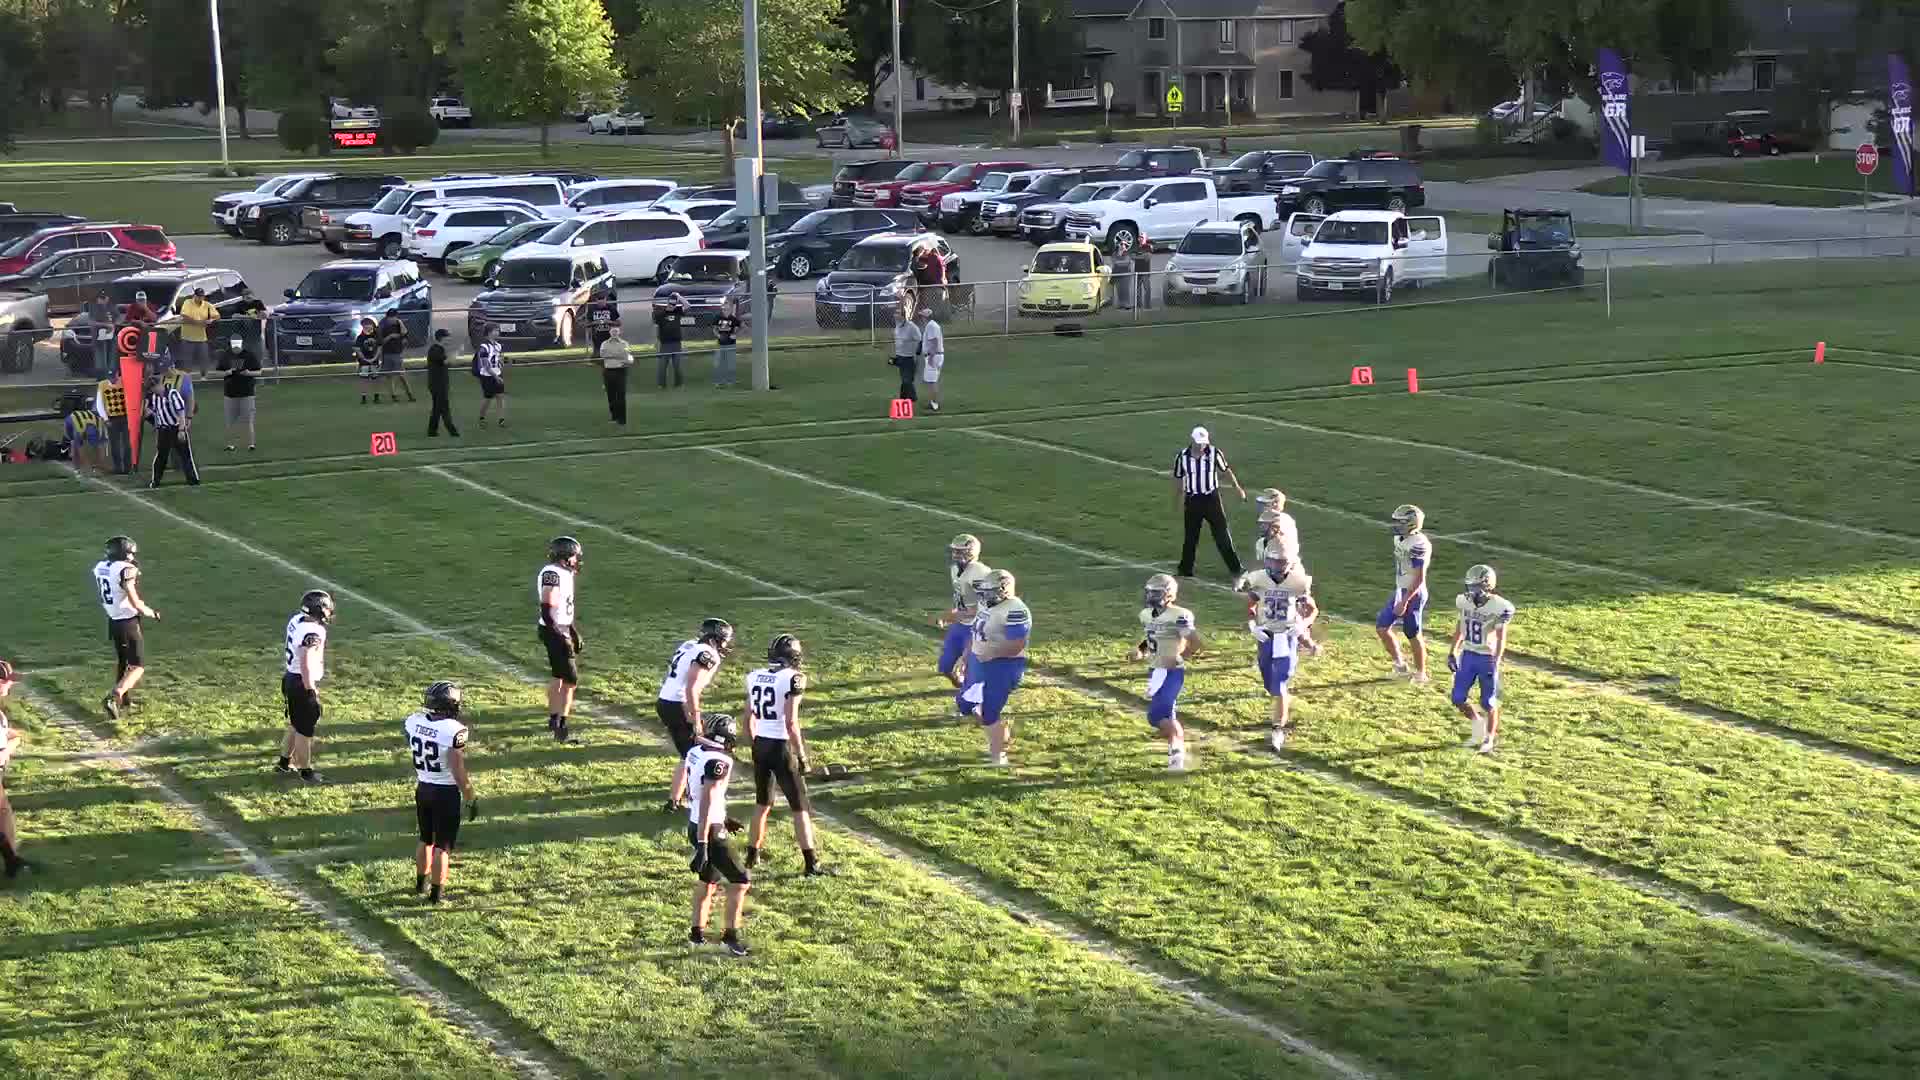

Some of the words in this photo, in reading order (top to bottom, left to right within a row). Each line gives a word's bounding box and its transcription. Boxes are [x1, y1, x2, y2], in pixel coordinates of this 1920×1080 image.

[1856, 152, 1877, 165] STOP
[1358, 368, 1370, 384] G
[895, 400, 911, 417] 10
[375, 435, 394, 453] 20
[1465, 619, 1482, 644] 18
[752, 685, 778, 720] 32
[411, 736, 442, 772] 22
